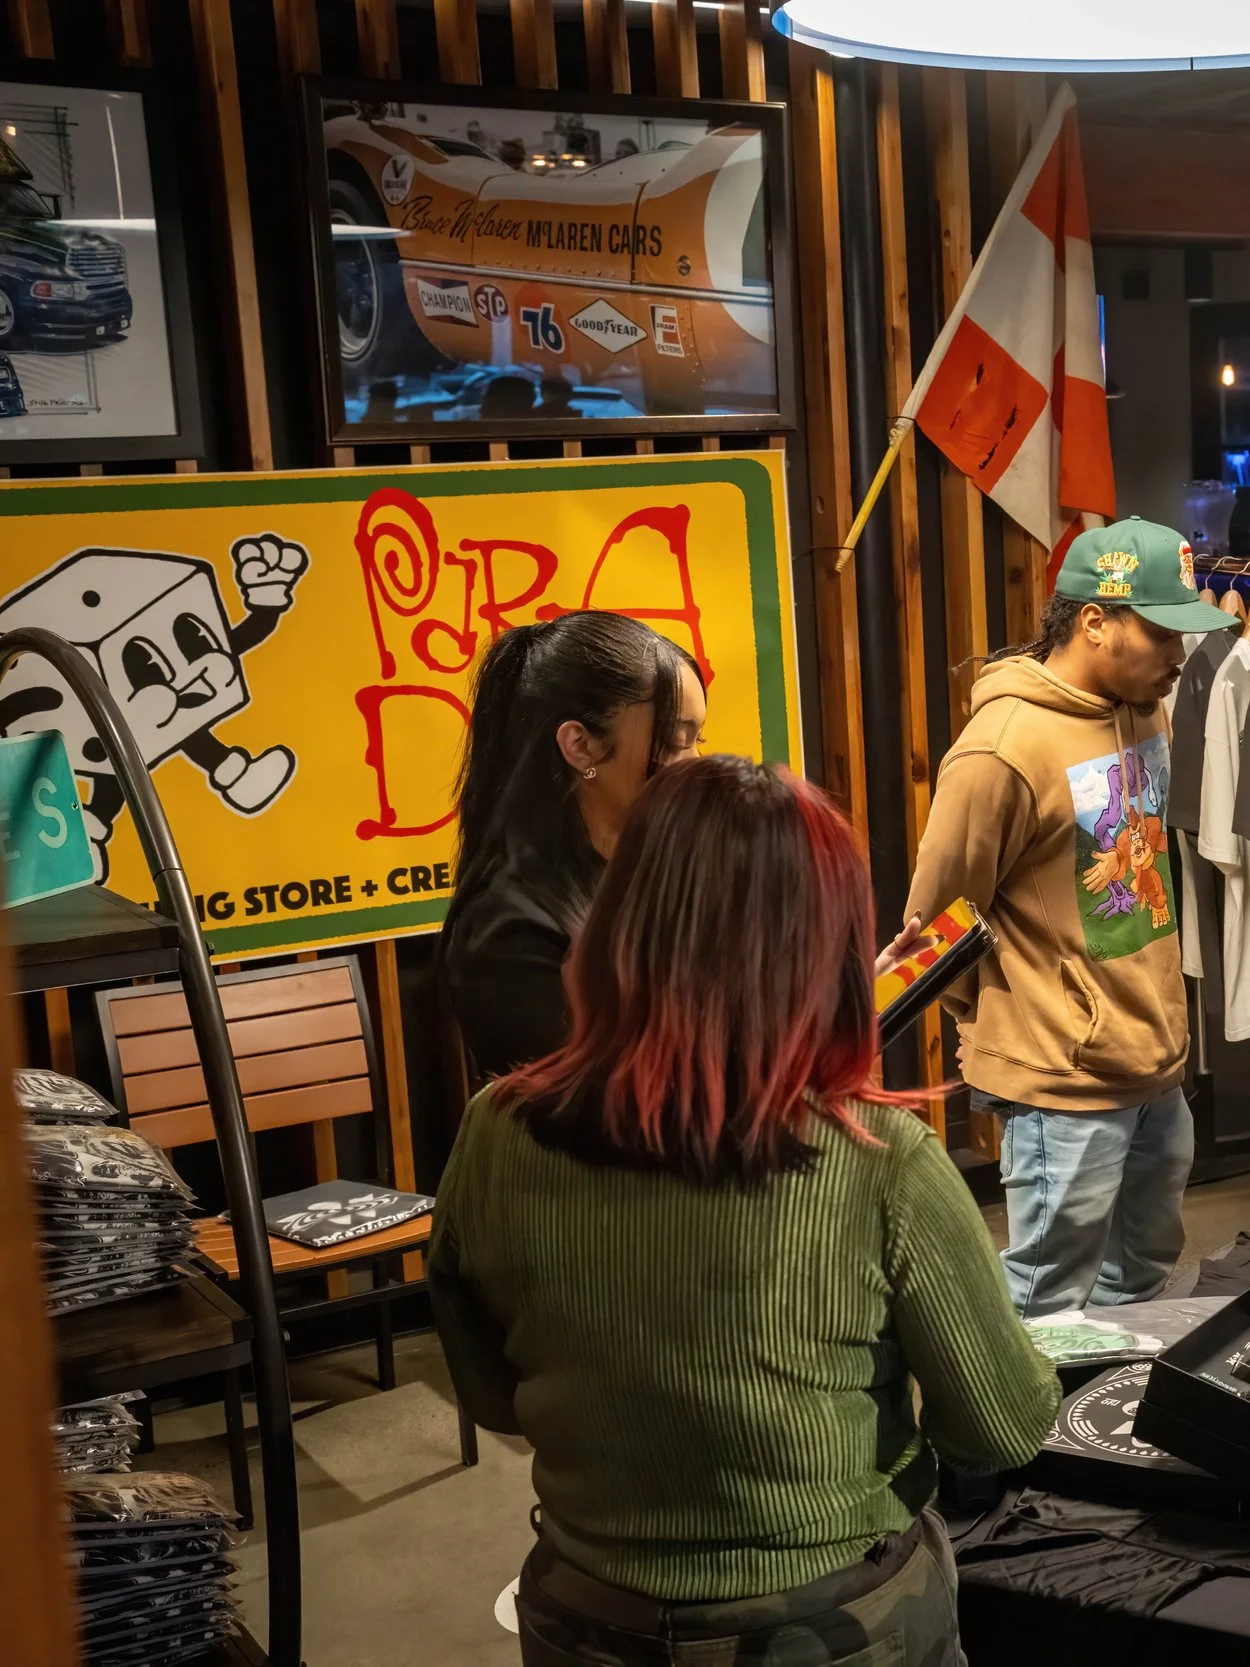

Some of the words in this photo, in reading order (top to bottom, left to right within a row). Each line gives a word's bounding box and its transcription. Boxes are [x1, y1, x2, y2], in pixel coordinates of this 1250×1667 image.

[608, 224, 663, 257] CARS
[420, 290, 472, 313] CHAMPION
[476, 286, 506, 319] STP
[520, 302, 565, 354] 76
[657, 343, 683, 354] FILTERS
[1099, 581, 1132, 597] HEMP
[32, 776, 68, 848] S
[245, 875, 352, 917] STORE
[361, 879, 379, 897] +
[386, 862, 453, 896] CRE
